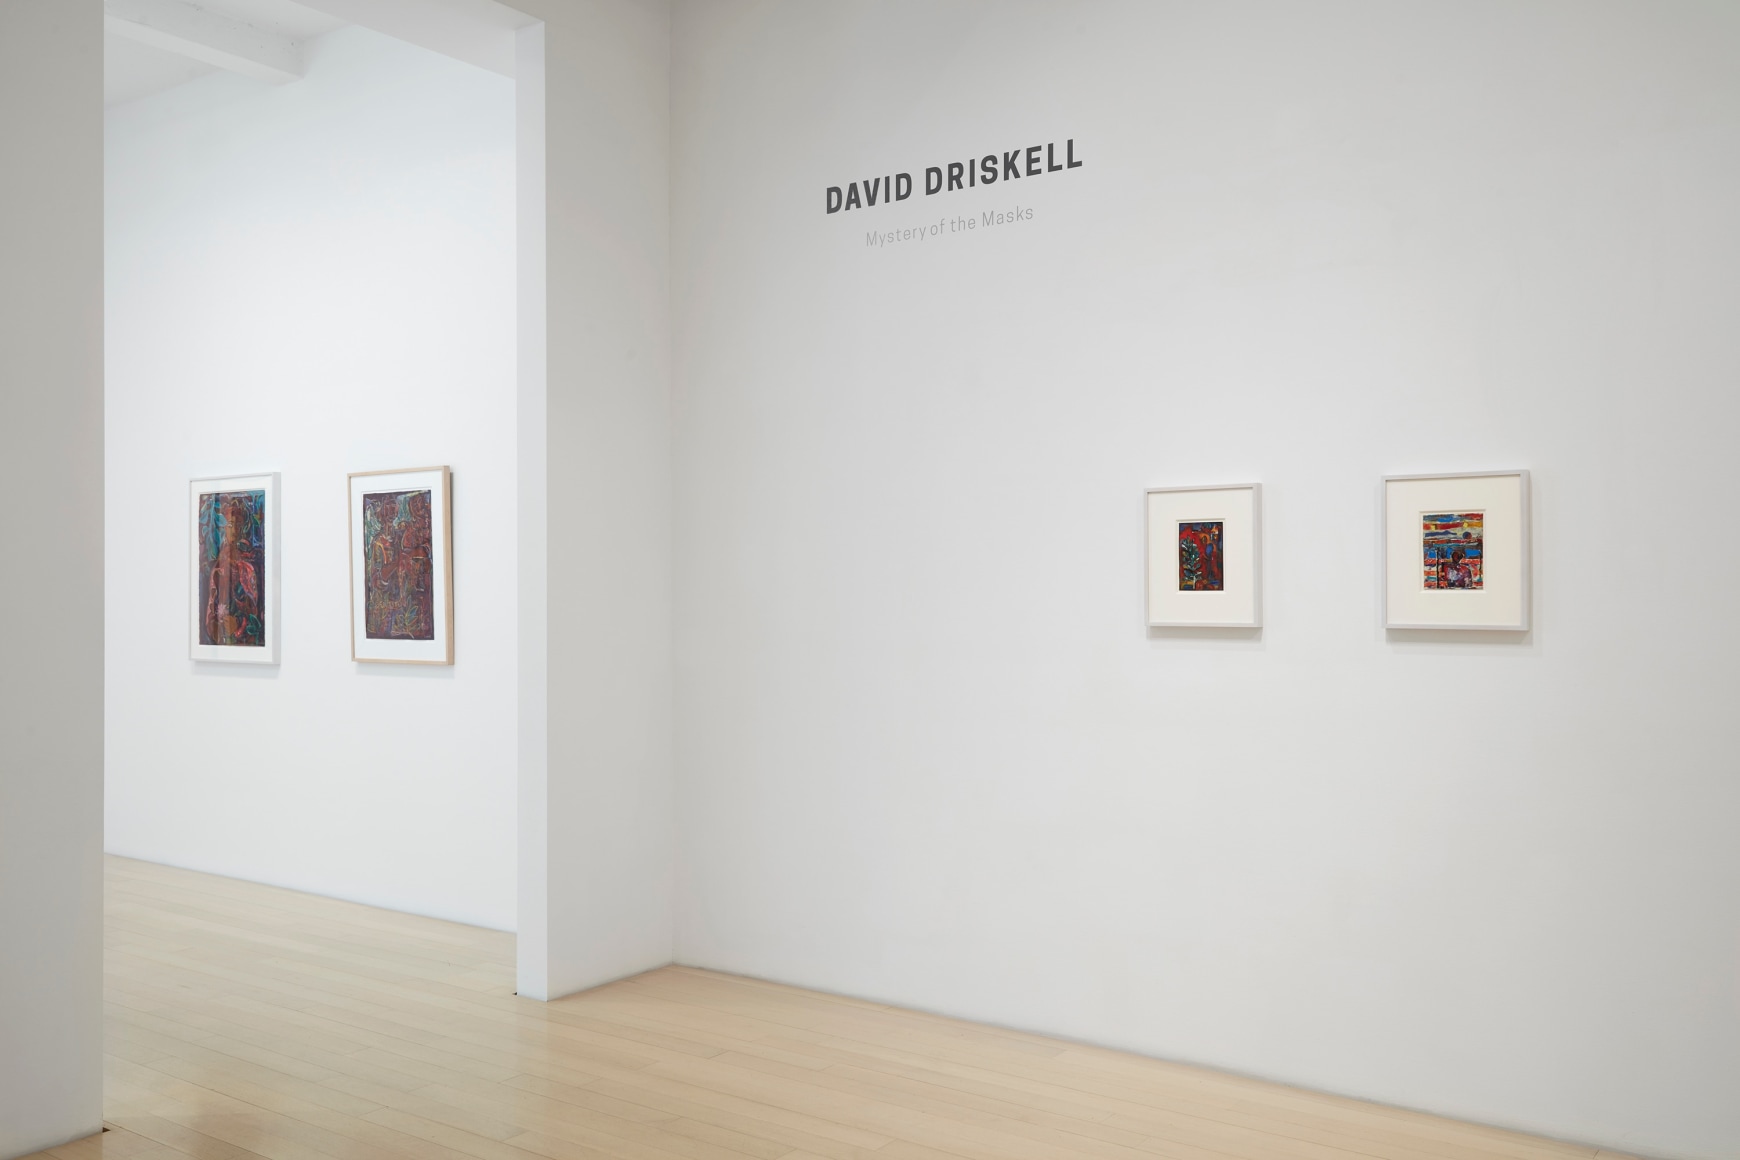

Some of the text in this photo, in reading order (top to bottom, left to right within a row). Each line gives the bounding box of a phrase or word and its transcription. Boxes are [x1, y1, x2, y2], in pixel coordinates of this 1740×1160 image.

[826, 138, 1083, 215] DAVID DRISKELL
[866, 205, 1034, 248] Mystery of the Masks
